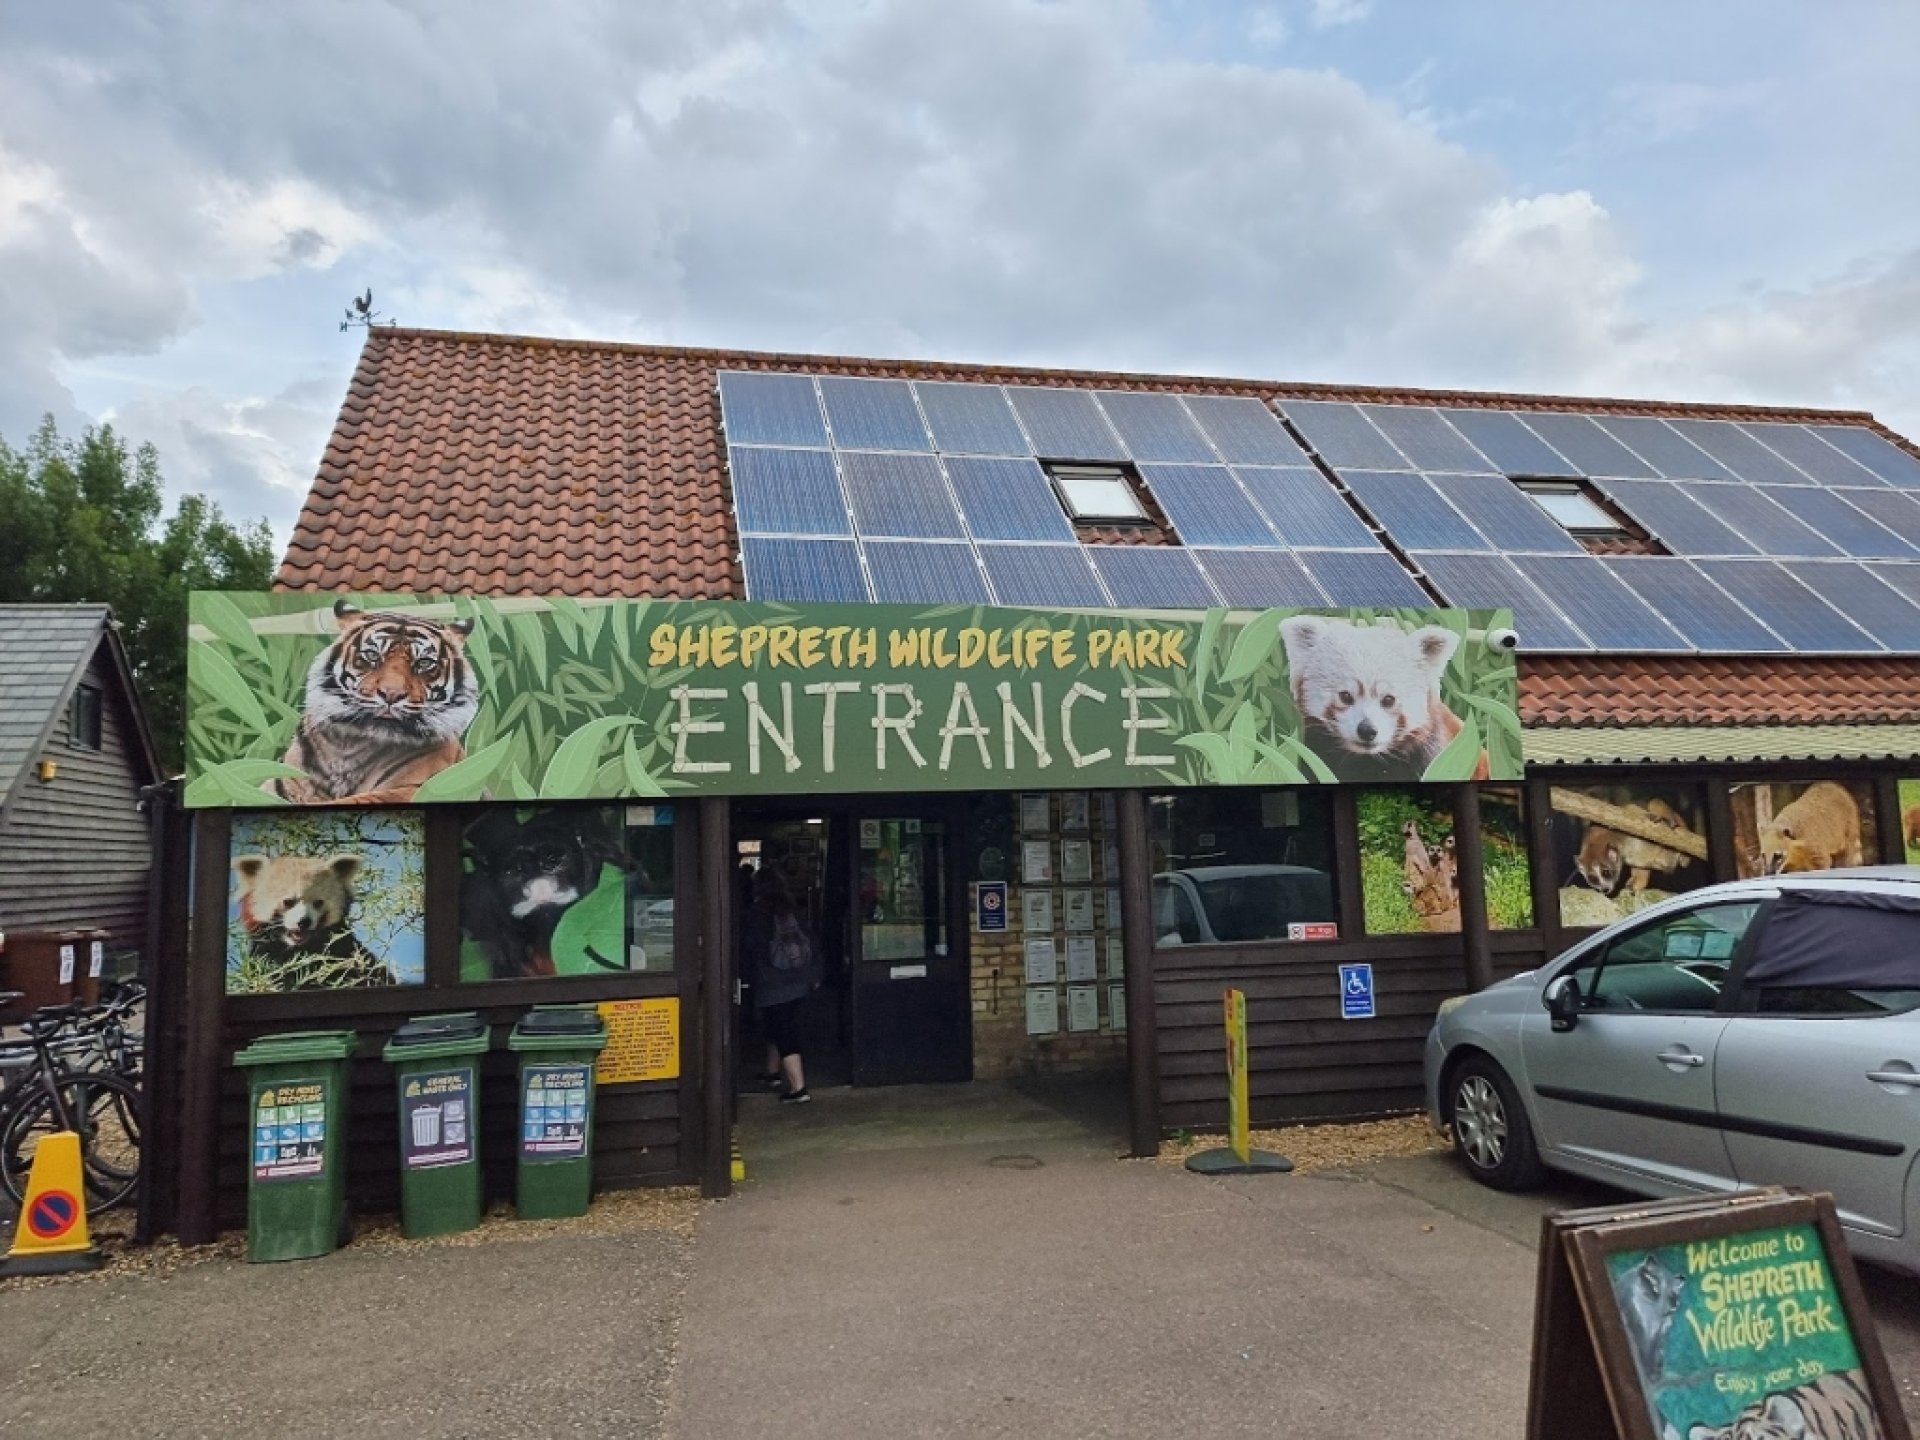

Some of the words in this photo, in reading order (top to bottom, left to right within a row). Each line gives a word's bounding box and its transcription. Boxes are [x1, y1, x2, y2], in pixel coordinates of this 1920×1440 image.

[648, 623, 877, 669] SHEPRETH
[888, 626, 1076, 670] WILDLIFE
[1087, 628, 1188, 670] PARK
[669, 681, 1177, 775] ENTRANCE
[1686, 1239, 1779, 1274] Welcome
[1785, 1232, 1805, 1252] to
[1701, 1259, 1824, 1312] SHEPRETH
[1686, 1302, 1778, 1357] Wildlife
[1779, 1296, 1841, 1346] Park
[1714, 1372, 1758, 1393] Enjoy
[1764, 1369, 1792, 1388] your
